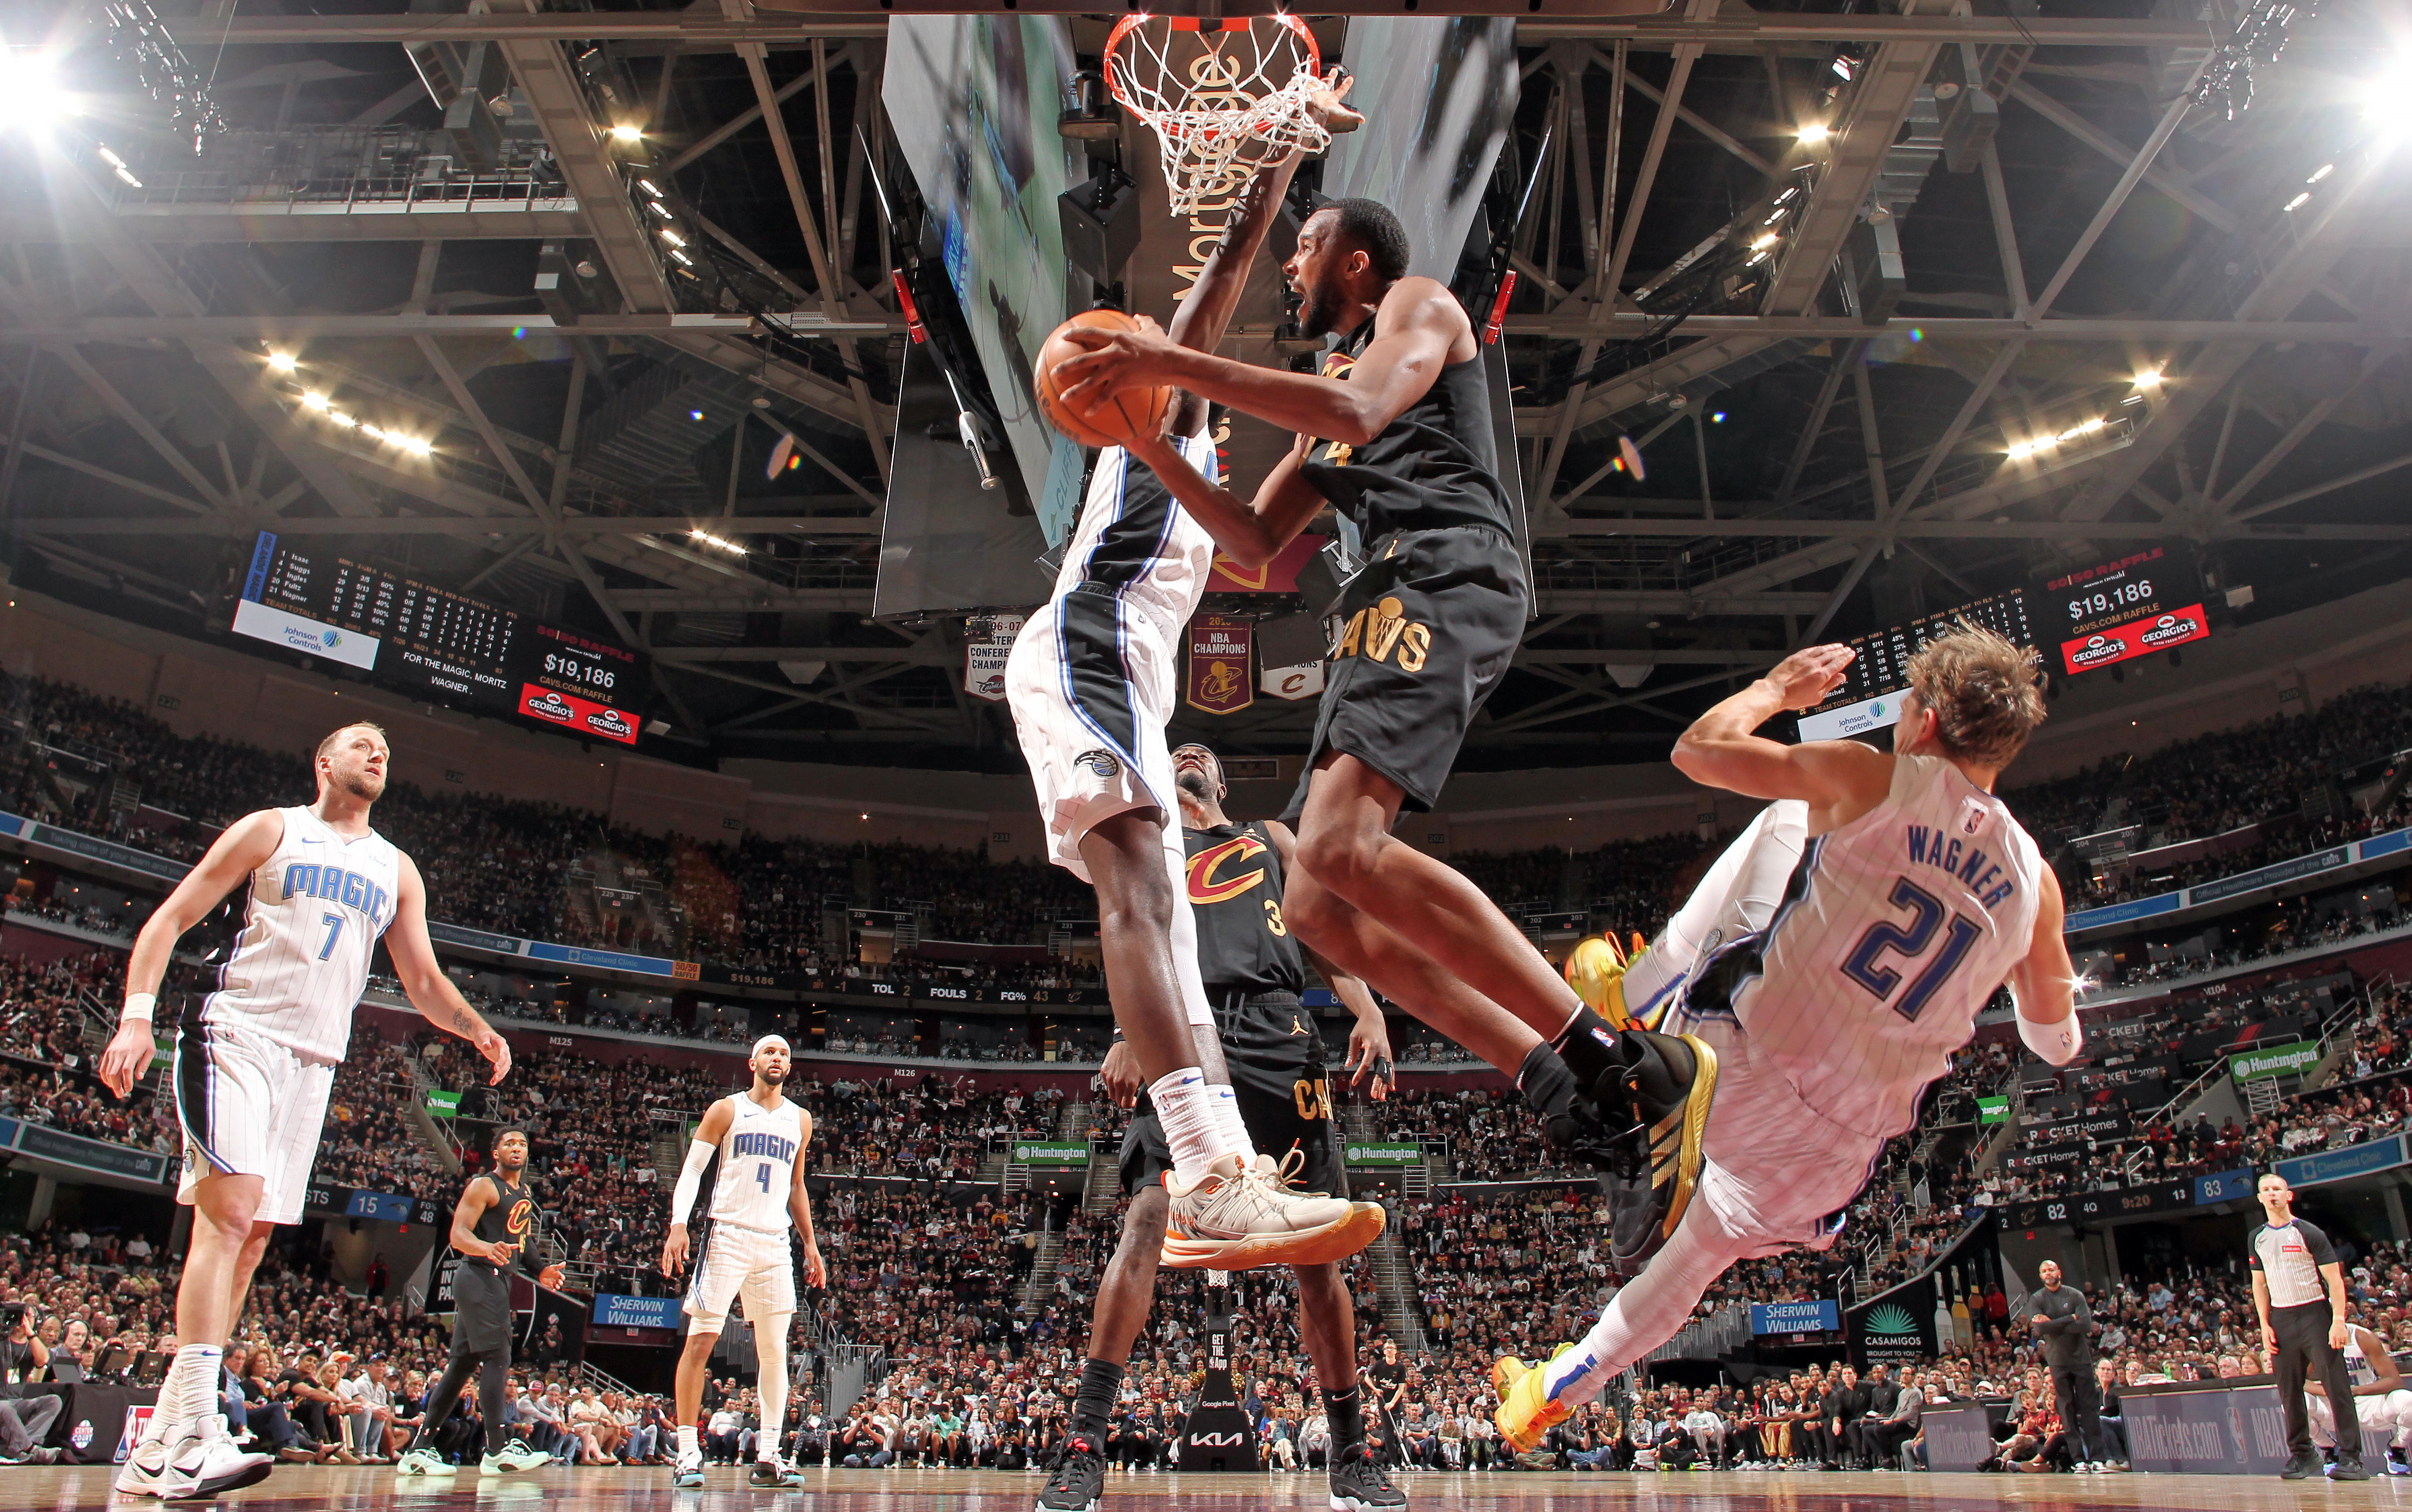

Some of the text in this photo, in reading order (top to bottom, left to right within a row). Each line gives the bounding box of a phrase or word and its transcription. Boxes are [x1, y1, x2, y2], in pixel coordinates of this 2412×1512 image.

[1323, 441, 1352, 466] 4
[291, 553, 309, 564] Isaac
[2097, 547, 2164, 575] RAFFLE
[289, 563, 310, 575] Suggs
[287, 572, 307, 583] Ingles
[285, 581, 301, 591] Fultz
[281, 590, 307, 602] Wagner
[2068, 580, 2153, 620] $19,186
[284, 626, 318, 642] Johnson
[1211, 633, 1229, 643] NBA
[2141, 621, 2197, 644] GEORGIO'S
[289, 636, 322, 651] Controls
[1194, 644, 1246, 653] CHAMPIONS
[2072, 642, 2125, 663] GEORGIO'S
[403, 652, 422, 664] FOR
[424, 658, 441, 669] THE
[475, 673, 507, 688] MORITZ
[544, 653, 615, 688] $19,186
[431, 676, 469, 693] WAGNER
[528, 699, 575, 718] GEORGIO'S
[1815, 703, 1833, 713] TEAM
[1834, 696, 1858, 706] TOTALS
[587, 716, 631, 734] GEORGIO'S
[1839, 715, 1866, 727] Johnson
[1844, 720, 1873, 732] Controls
[1908, 825, 2012, 909] WAGNER
[2196, 887, 2221, 899] Official
[2222, 876, 2263, 891] Healthcare
[2264, 868, 2296, 880] Provider
[2306, 861, 2319, 869] the
[282, 863, 387, 928] MAGIC
[2078, 908, 2139, 924] Cleveland Clinic
[318, 912, 345, 961] 7
[1840, 875, 1983, 1022] 21
[582, 953, 617, 964] Cleveland
[675, 962, 697, 971] 50/50
[731, 973, 774, 985] $19,186
[872, 984, 910, 996] TOL 2
[930, 988, 983, 1001] FOULS 2
[1001, 991, 1049, 1001] FG% 43
[2203, 984, 2226, 996] M104
[549, 1036, 572, 1047] M125
[2250, 1049, 2318, 1072] Huntington
[2030, 1119, 2118, 1140] ROCKET Homes
[733, 1133, 795, 1166] MAGIC
[1031, 1146, 1086, 1161] Huntington
[1362, 1147, 1417, 1161] Huntington
[2008, 1150, 2080, 1168] ROCKET Homes
[2318, 1152, 2382, 1173] Cleveland Clinic
[756, 1163, 772, 1193] 4
[358, 1196, 378, 1214] 15
[420, 1201, 437, 1211] FG%
[2048, 1180, 2222, 1220] 82 4Q 9:20 13 83
[420, 1212, 434, 1223] 48
[2001, 1219, 2008, 1228] 2
[610, 1295, 664, 1312] SHERWIN
[1766, 1304, 1819, 1318] SHERWIN
[1212, 1334, 1224, 1345] GET
[1865, 1337, 1921, 1346] CASAMIGOS
[1212, 1346, 1224, 1356] THE
[1215, 1357, 1227, 1370] App
[2127, 1414, 2223, 1460] NBATickets.com
